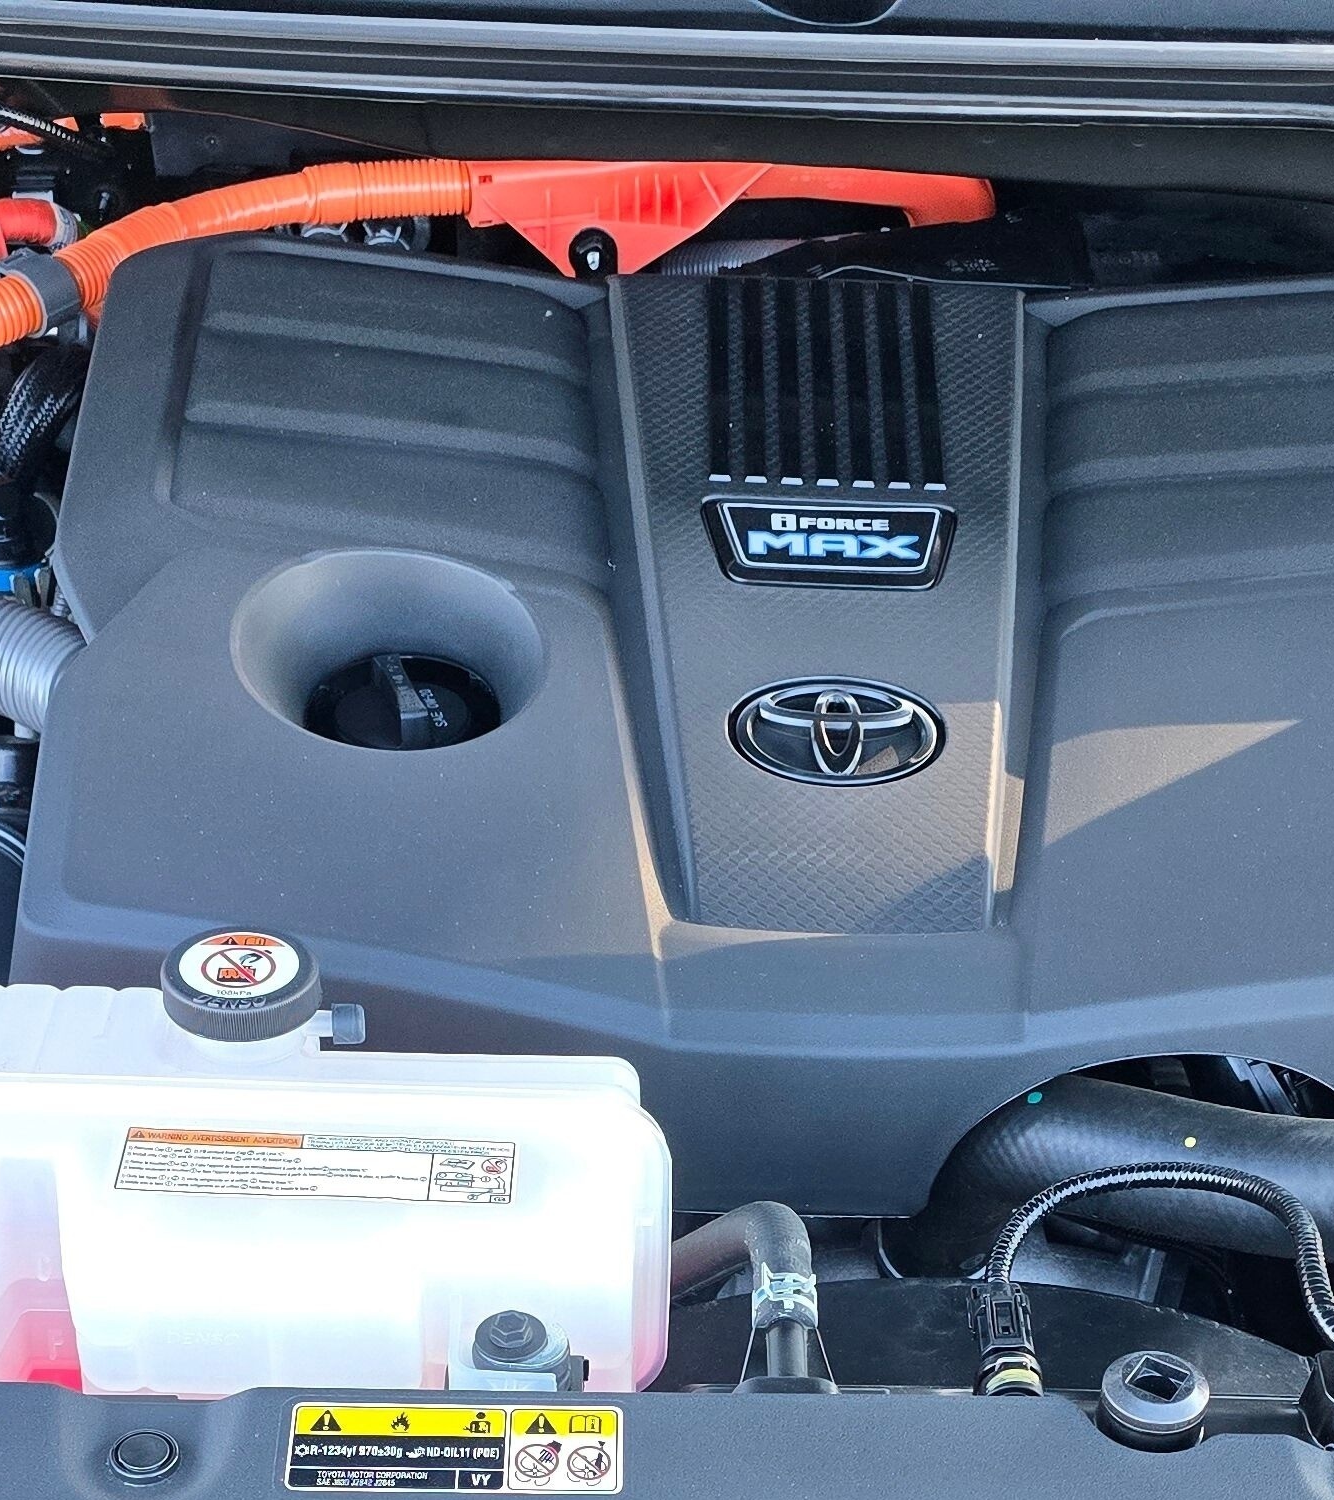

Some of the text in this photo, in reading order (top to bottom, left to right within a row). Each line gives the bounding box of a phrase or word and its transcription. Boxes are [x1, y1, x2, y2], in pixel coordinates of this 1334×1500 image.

[799, 516, 890, 532] FORCE
[747, 530, 921, 560] MAX
[430, 708, 448, 729] SAE
[192, 994, 267, 1011] DENSO
[147, 1132, 189, 1142] WARNING
[192, 1133, 251, 1144] AVERTISSEMENT
[309, 1444, 357, 1458] R-1234yf
[316, 1478, 331, 1486] SAE
[317, 1470, 429, 1480] TOYOTA MOTOR CORPORATION
[470, 1473, 491, 1487] VY
